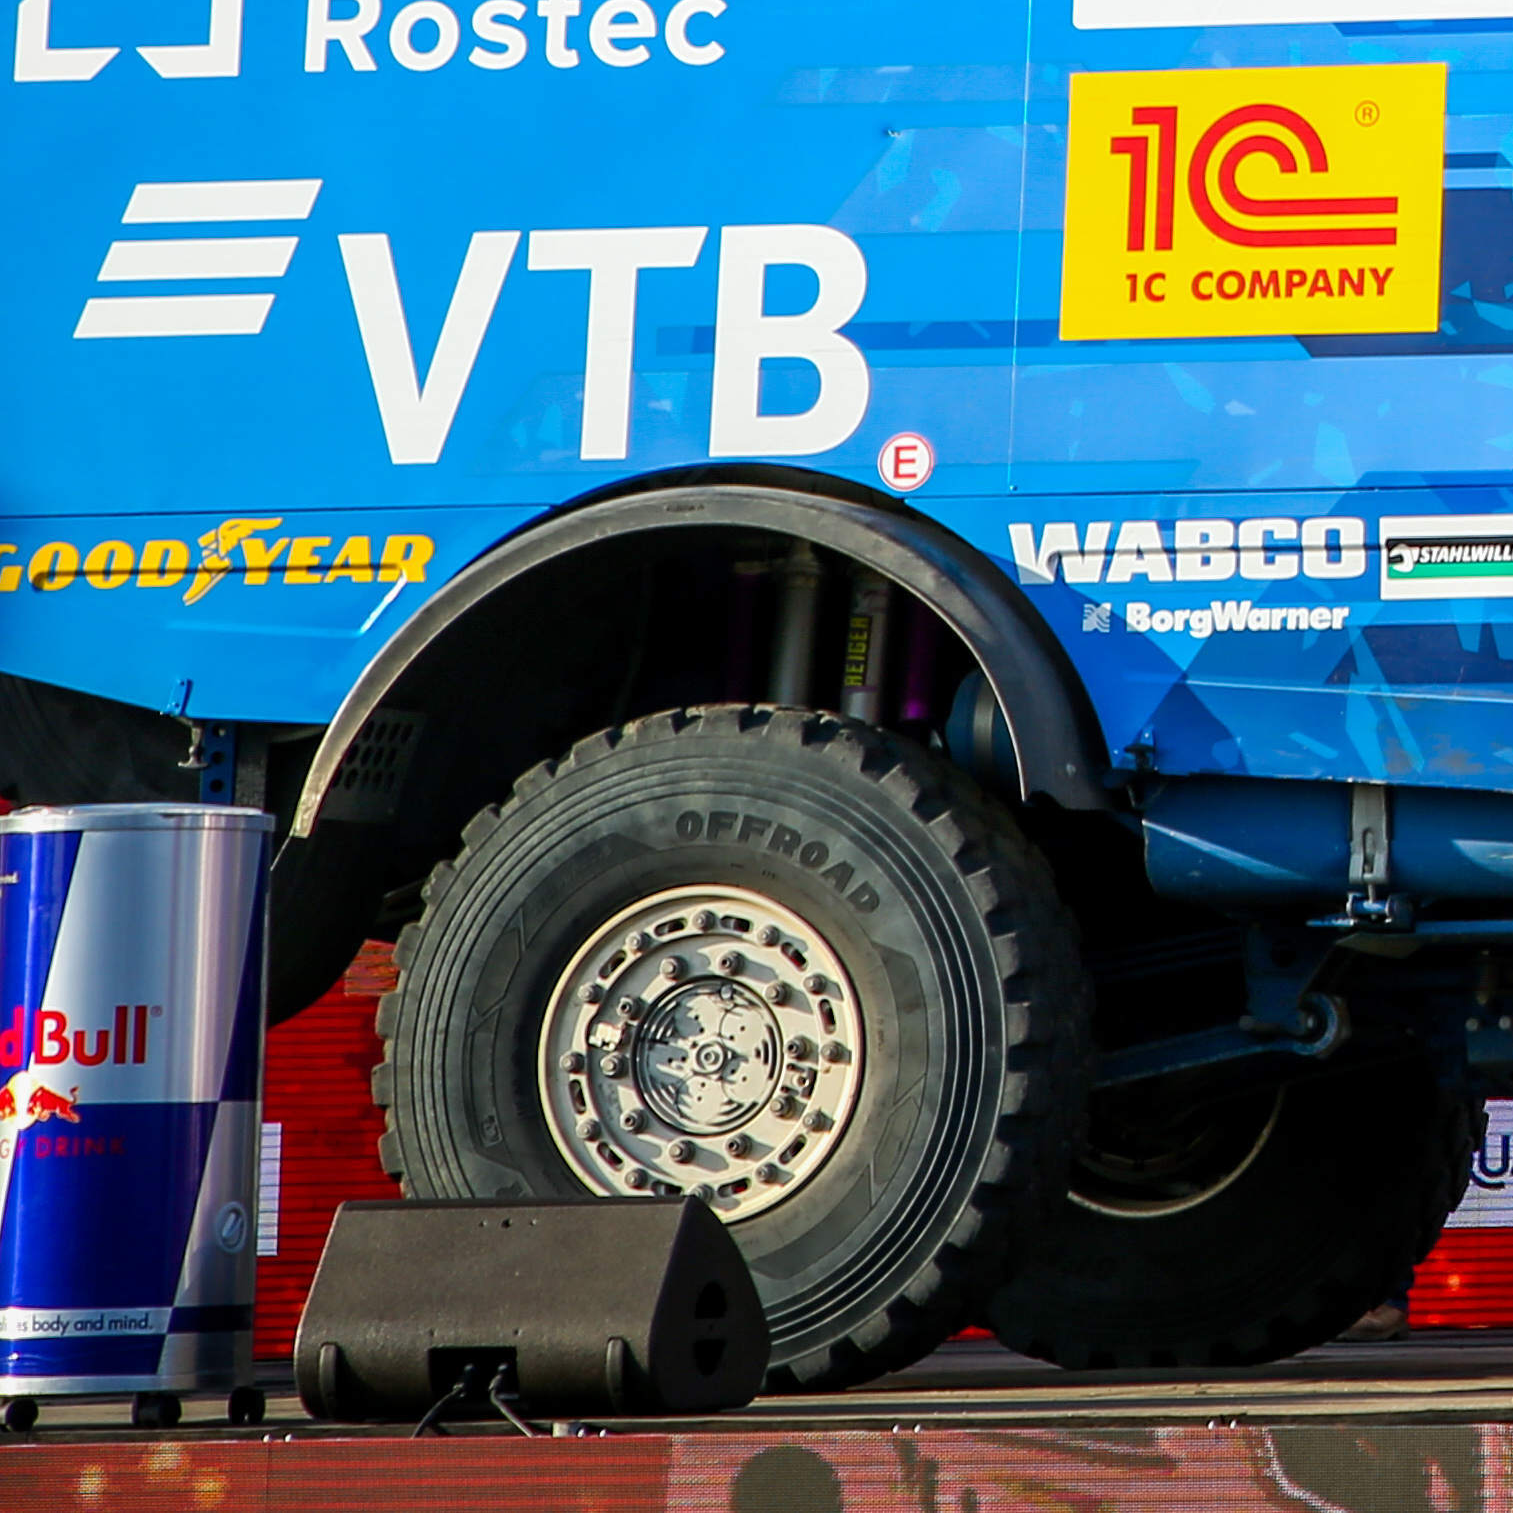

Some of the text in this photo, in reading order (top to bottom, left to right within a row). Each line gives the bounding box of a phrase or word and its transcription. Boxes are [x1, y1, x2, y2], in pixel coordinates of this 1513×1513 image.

[1125, 266, 1395, 303] 1C COMPANY
[337, 223, 871, 466] VTB
[893, 444, 919, 480] E
[0, 533, 436, 593] GOODYEAR
[1006, 515, 1367, 587] WABCO
[1126, 600, 1350, 638] BorgWarner
[674, 810, 882, 917] OFFROAD
[34, 1005, 148, 1066] Bull
[31, 1314, 70, 1336] body
[73, 1313, 105, 1332] and
[107, 1312, 154, 1331] mind.
